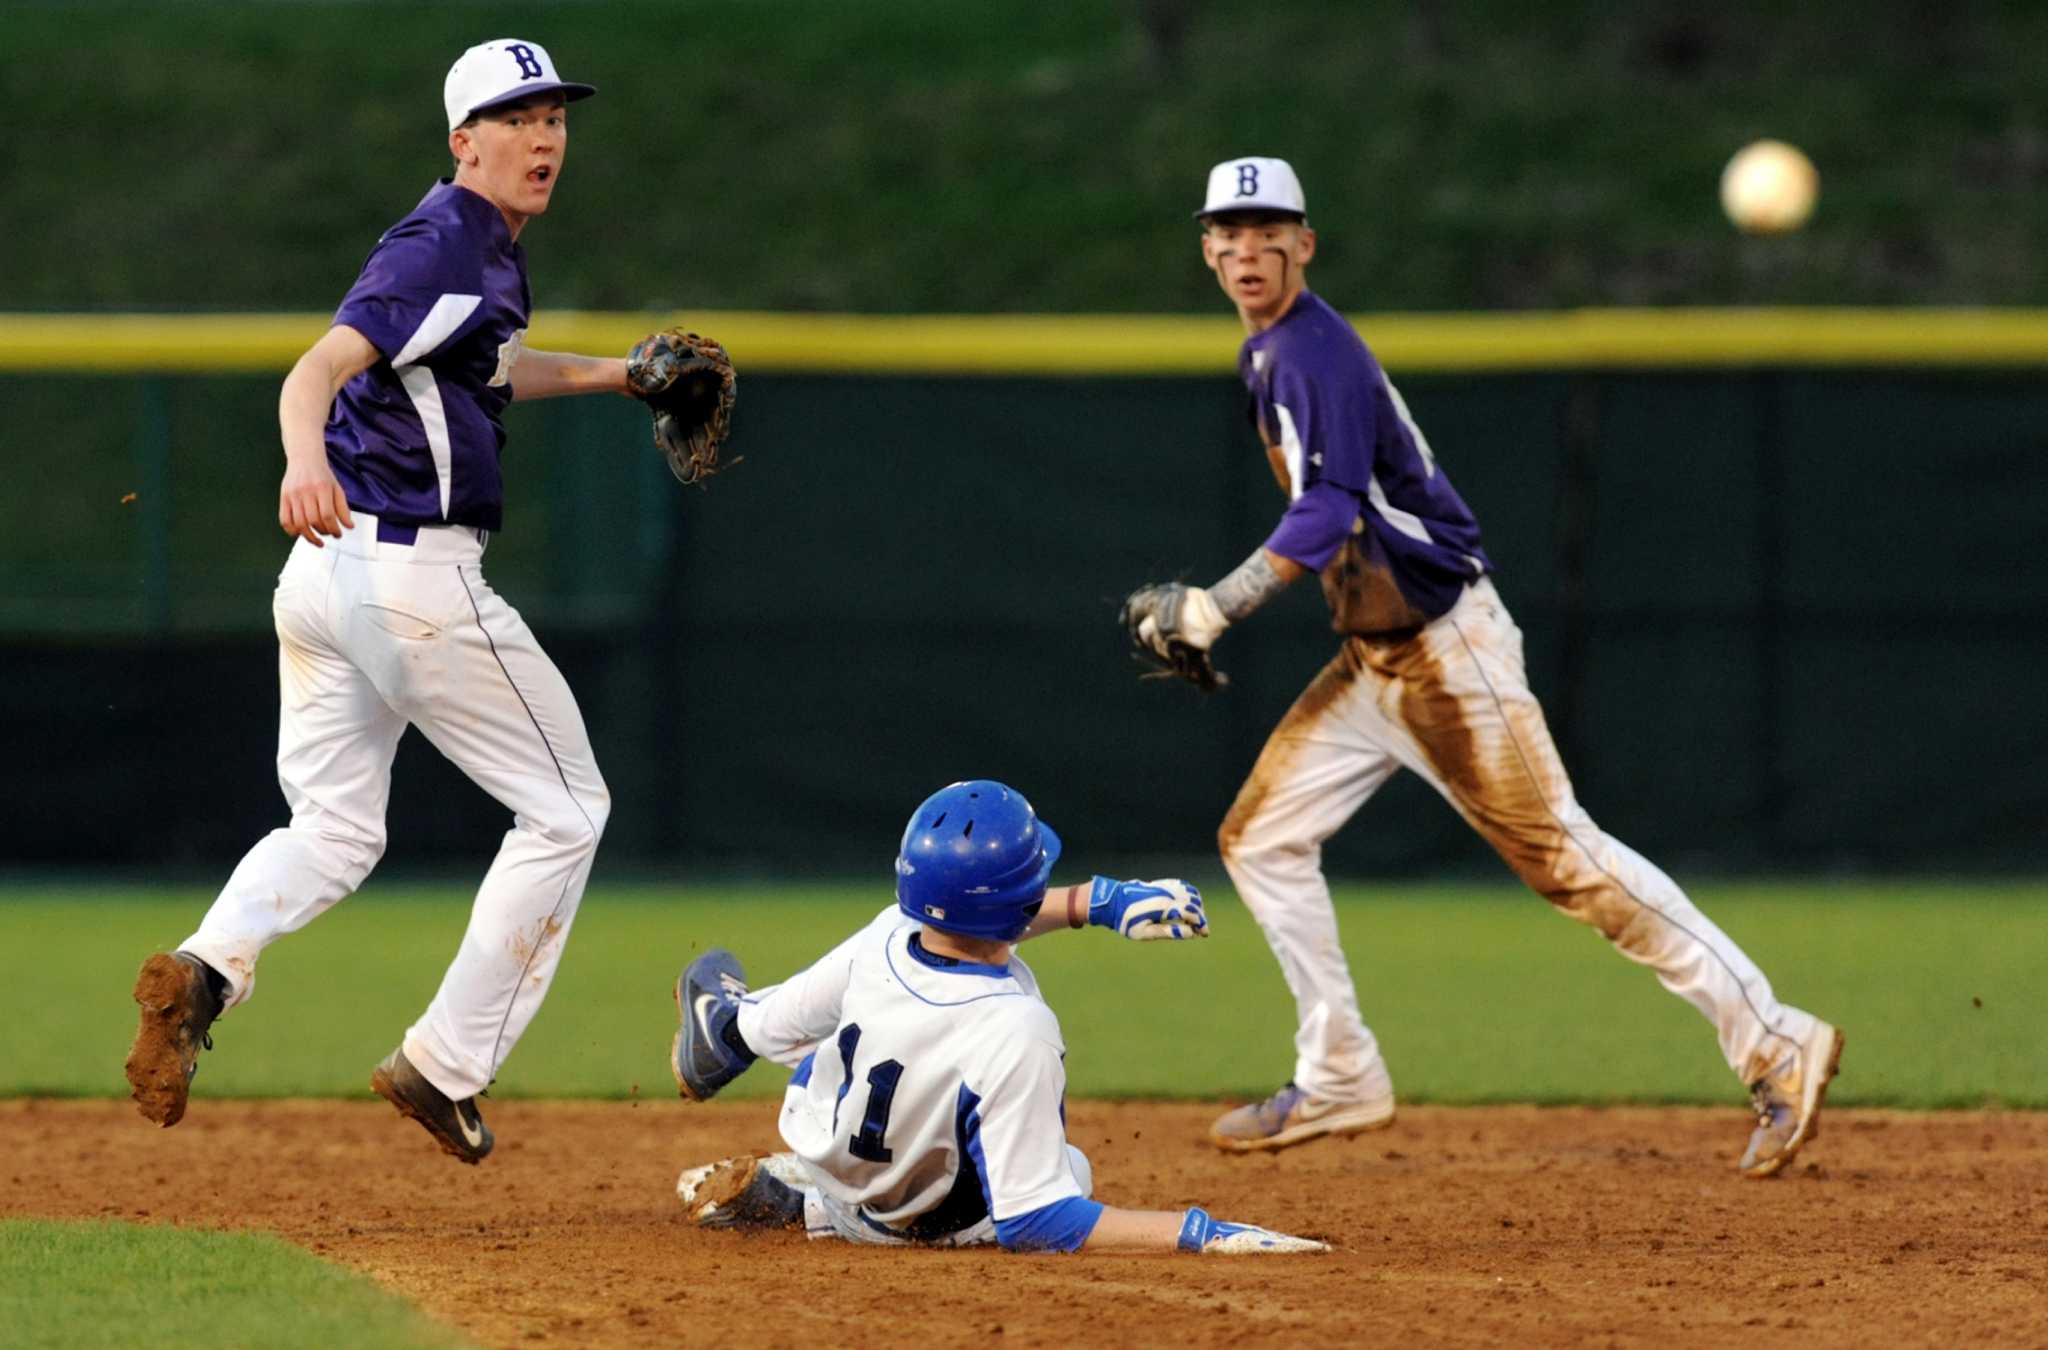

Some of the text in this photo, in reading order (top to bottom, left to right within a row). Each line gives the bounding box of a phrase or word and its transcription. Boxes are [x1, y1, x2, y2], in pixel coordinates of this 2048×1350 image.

[505, 44, 543, 80] B
[1235, 164, 1259, 198] B
[832, 1022, 904, 1163] 11
